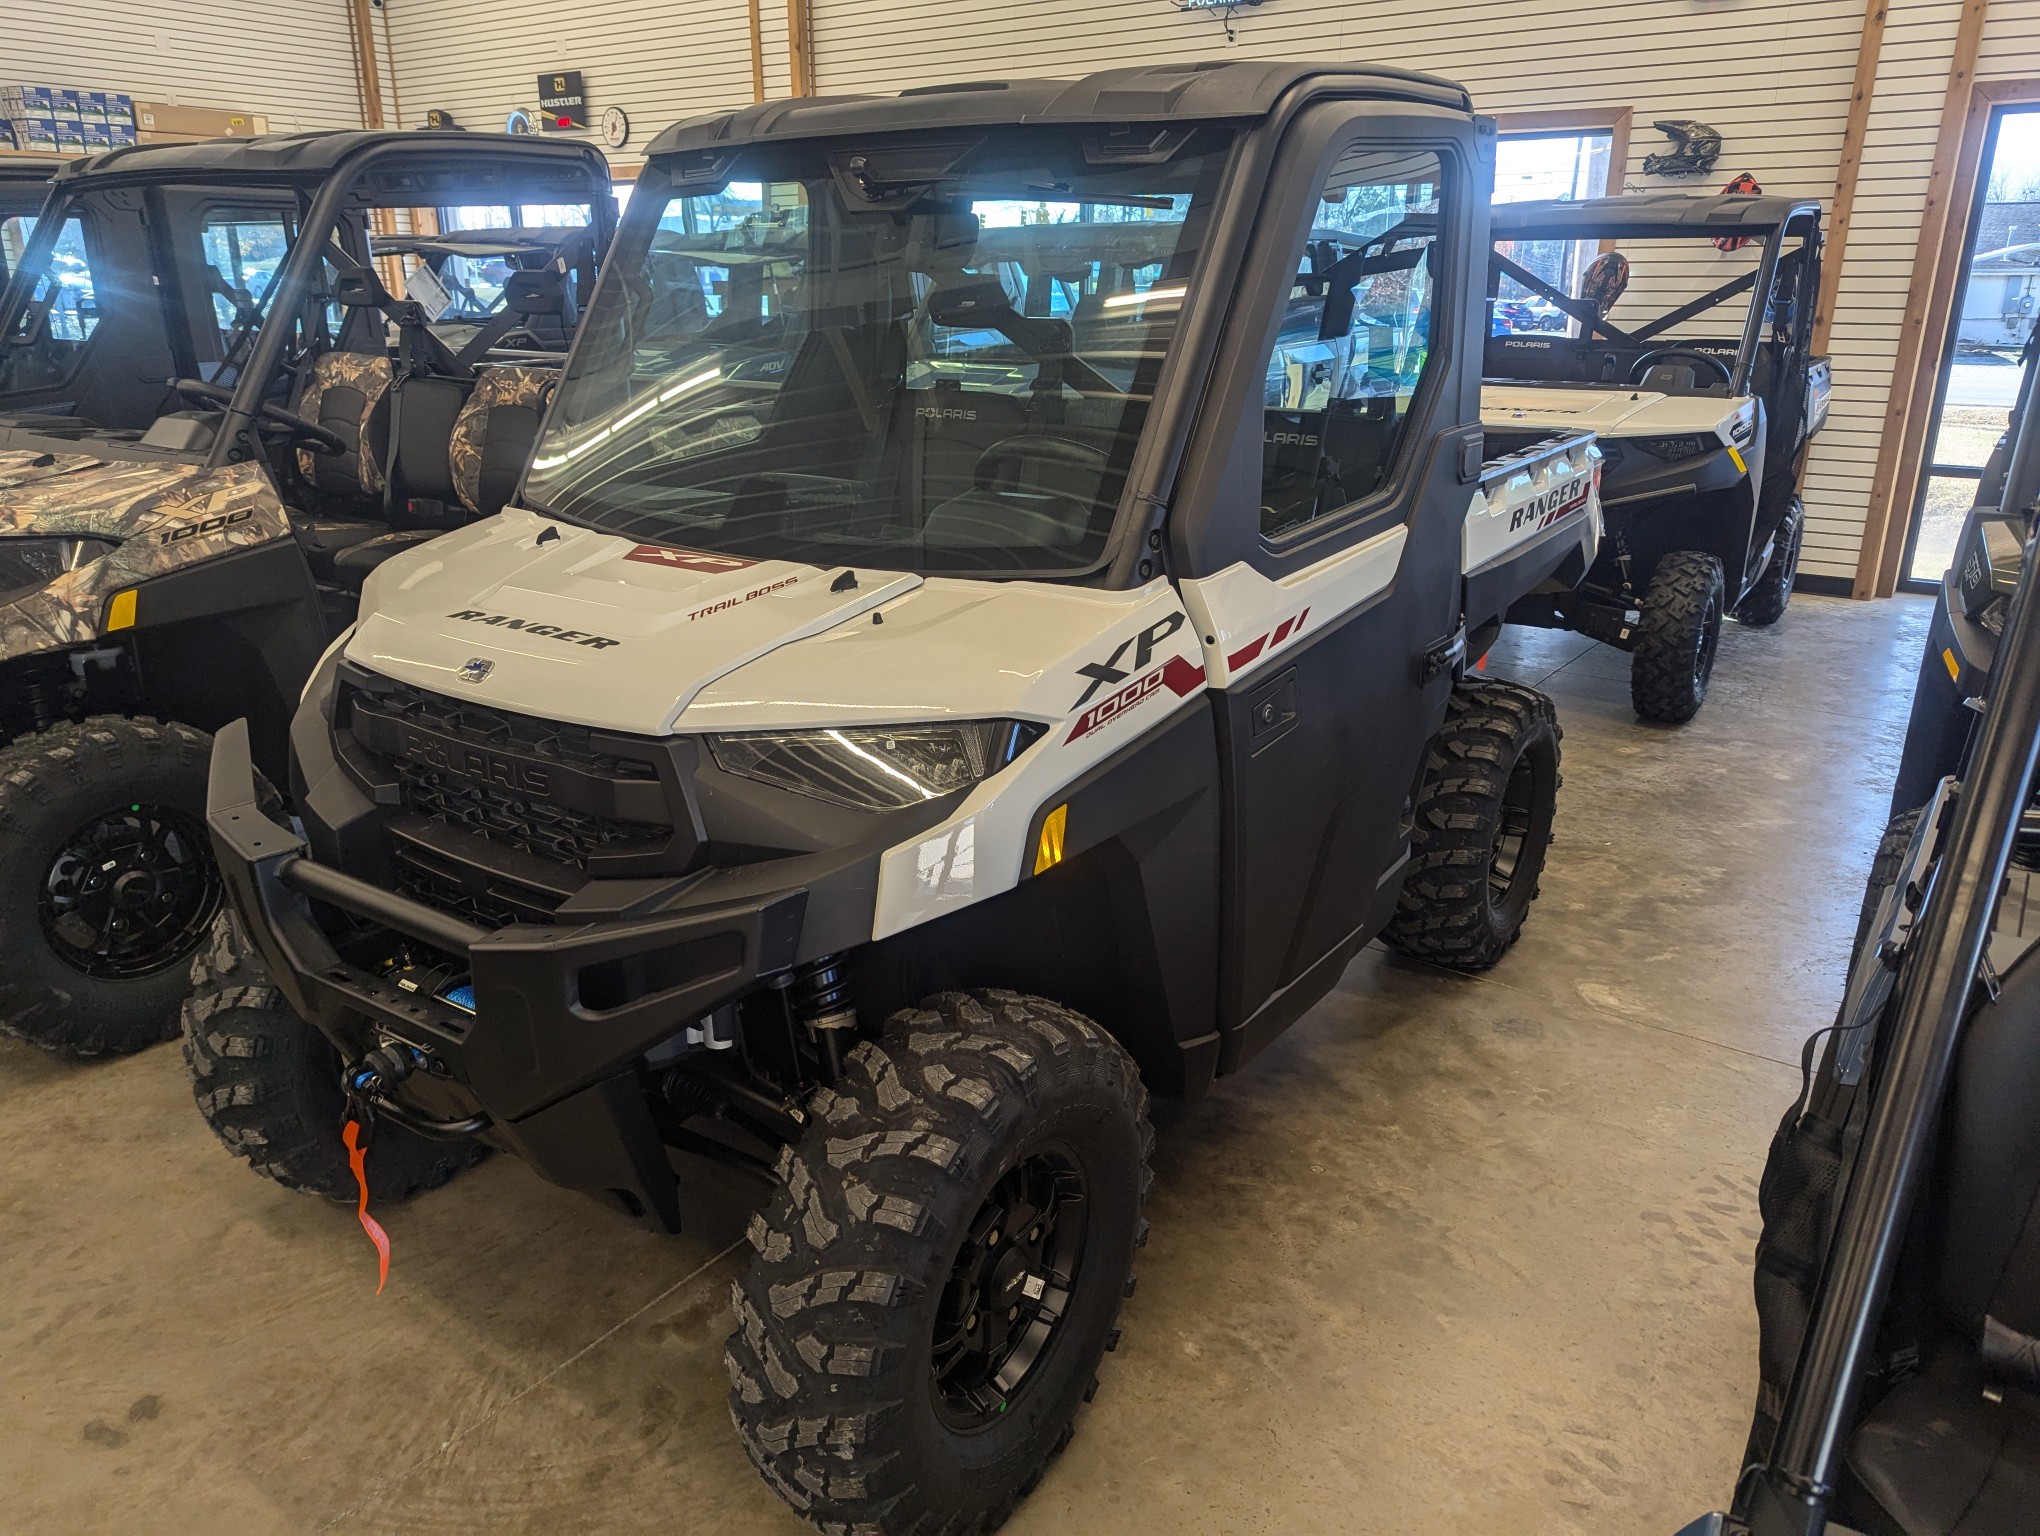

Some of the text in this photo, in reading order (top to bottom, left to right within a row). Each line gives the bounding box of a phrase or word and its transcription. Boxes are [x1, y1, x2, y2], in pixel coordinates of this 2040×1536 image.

[540, 96, 583, 108] HUSTLER
[1505, 341, 1551, 349] POLARIS
[1694, 347, 1740, 356] OLARI
[915, 407, 977, 421] POLARIS
[1264, 431, 1319, 447] LARIS
[140, 481, 266, 534] XP
[160, 506, 254, 545] 1000
[1509, 478, 1581, 533] RANGER
[687, 575, 798, 622] TRAIL BOSS
[445, 609, 621, 650] RANGER
[1067, 610, 1186, 714] XP
[1087, 667, 1165, 729] 1000
[404, 734, 551, 798] POLARIS
